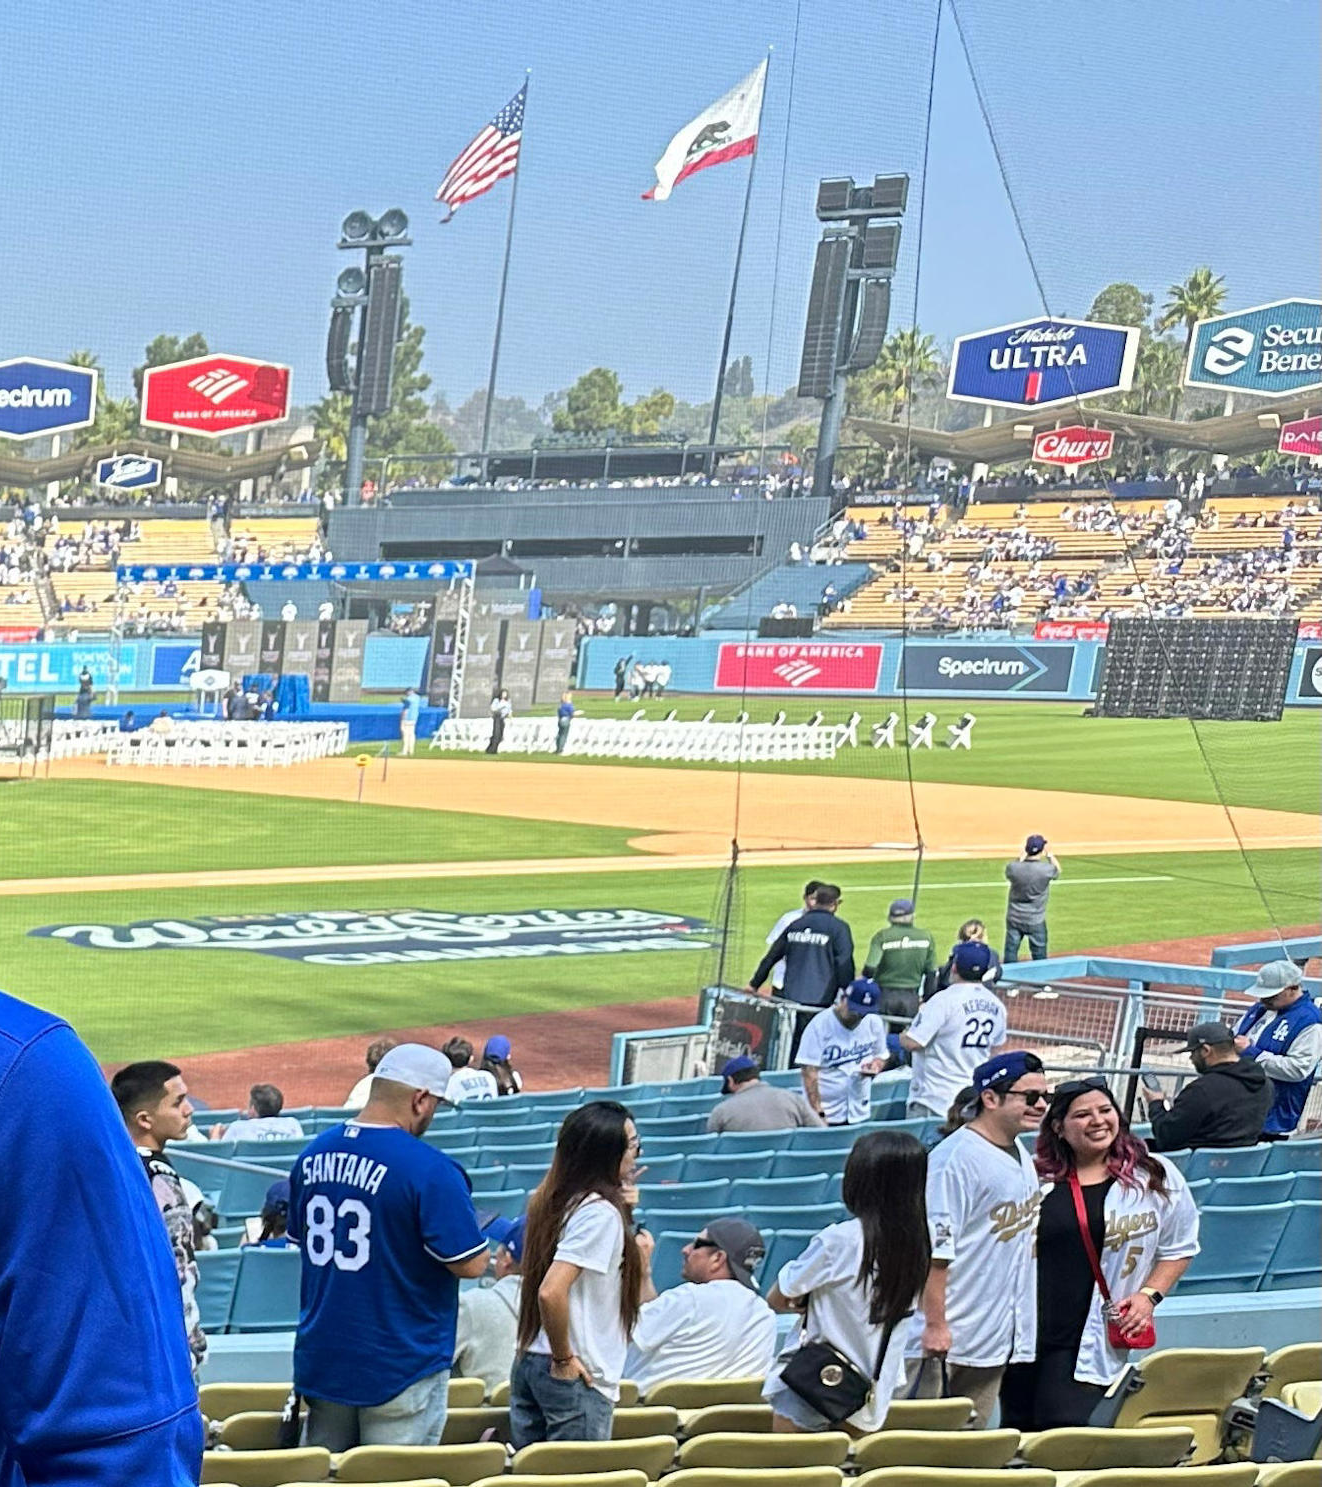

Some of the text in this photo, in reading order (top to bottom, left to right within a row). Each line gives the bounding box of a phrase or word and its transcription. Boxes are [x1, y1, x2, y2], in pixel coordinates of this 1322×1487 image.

[989, 343, 1087, 371] ULTRA
[1259, 350, 1322, 373] Bene
[736, 647, 864, 658] BANK OF AMERICA
[938, 657, 1024, 679] Spectrum
[52, 907, 685, 950] World Series
[961, 1018, 994, 1049] 22
[302, 1151, 389, 1196] SANTANA
[306, 1194, 371, 1272] 83
[1104, 1209, 1158, 1248] dgers
[1120, 1246, 1144, 1280] 5
